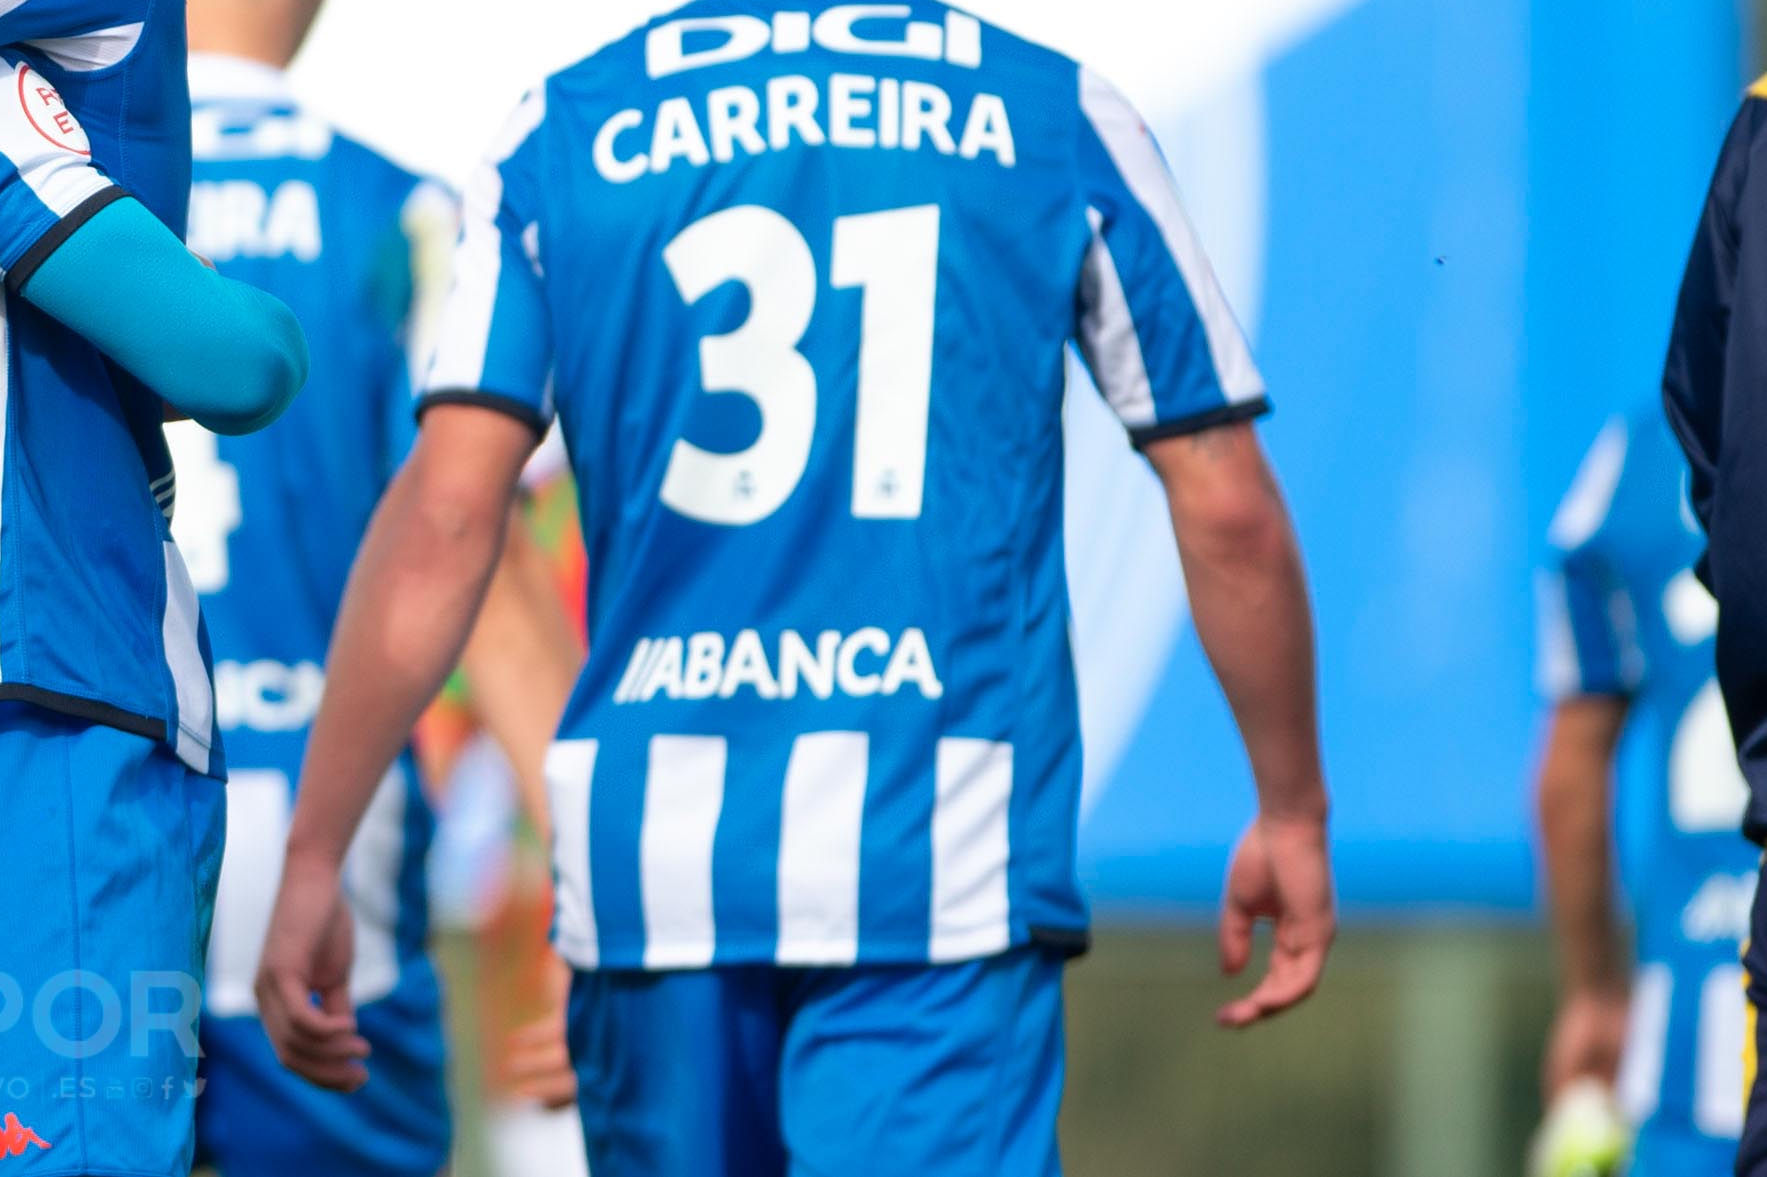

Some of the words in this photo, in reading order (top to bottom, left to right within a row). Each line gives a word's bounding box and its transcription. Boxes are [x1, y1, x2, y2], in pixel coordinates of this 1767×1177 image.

[644, 4, 982, 80] DIGI
[593, 72, 1017, 184] CARREIRA
[660, 204, 941, 526] 31
